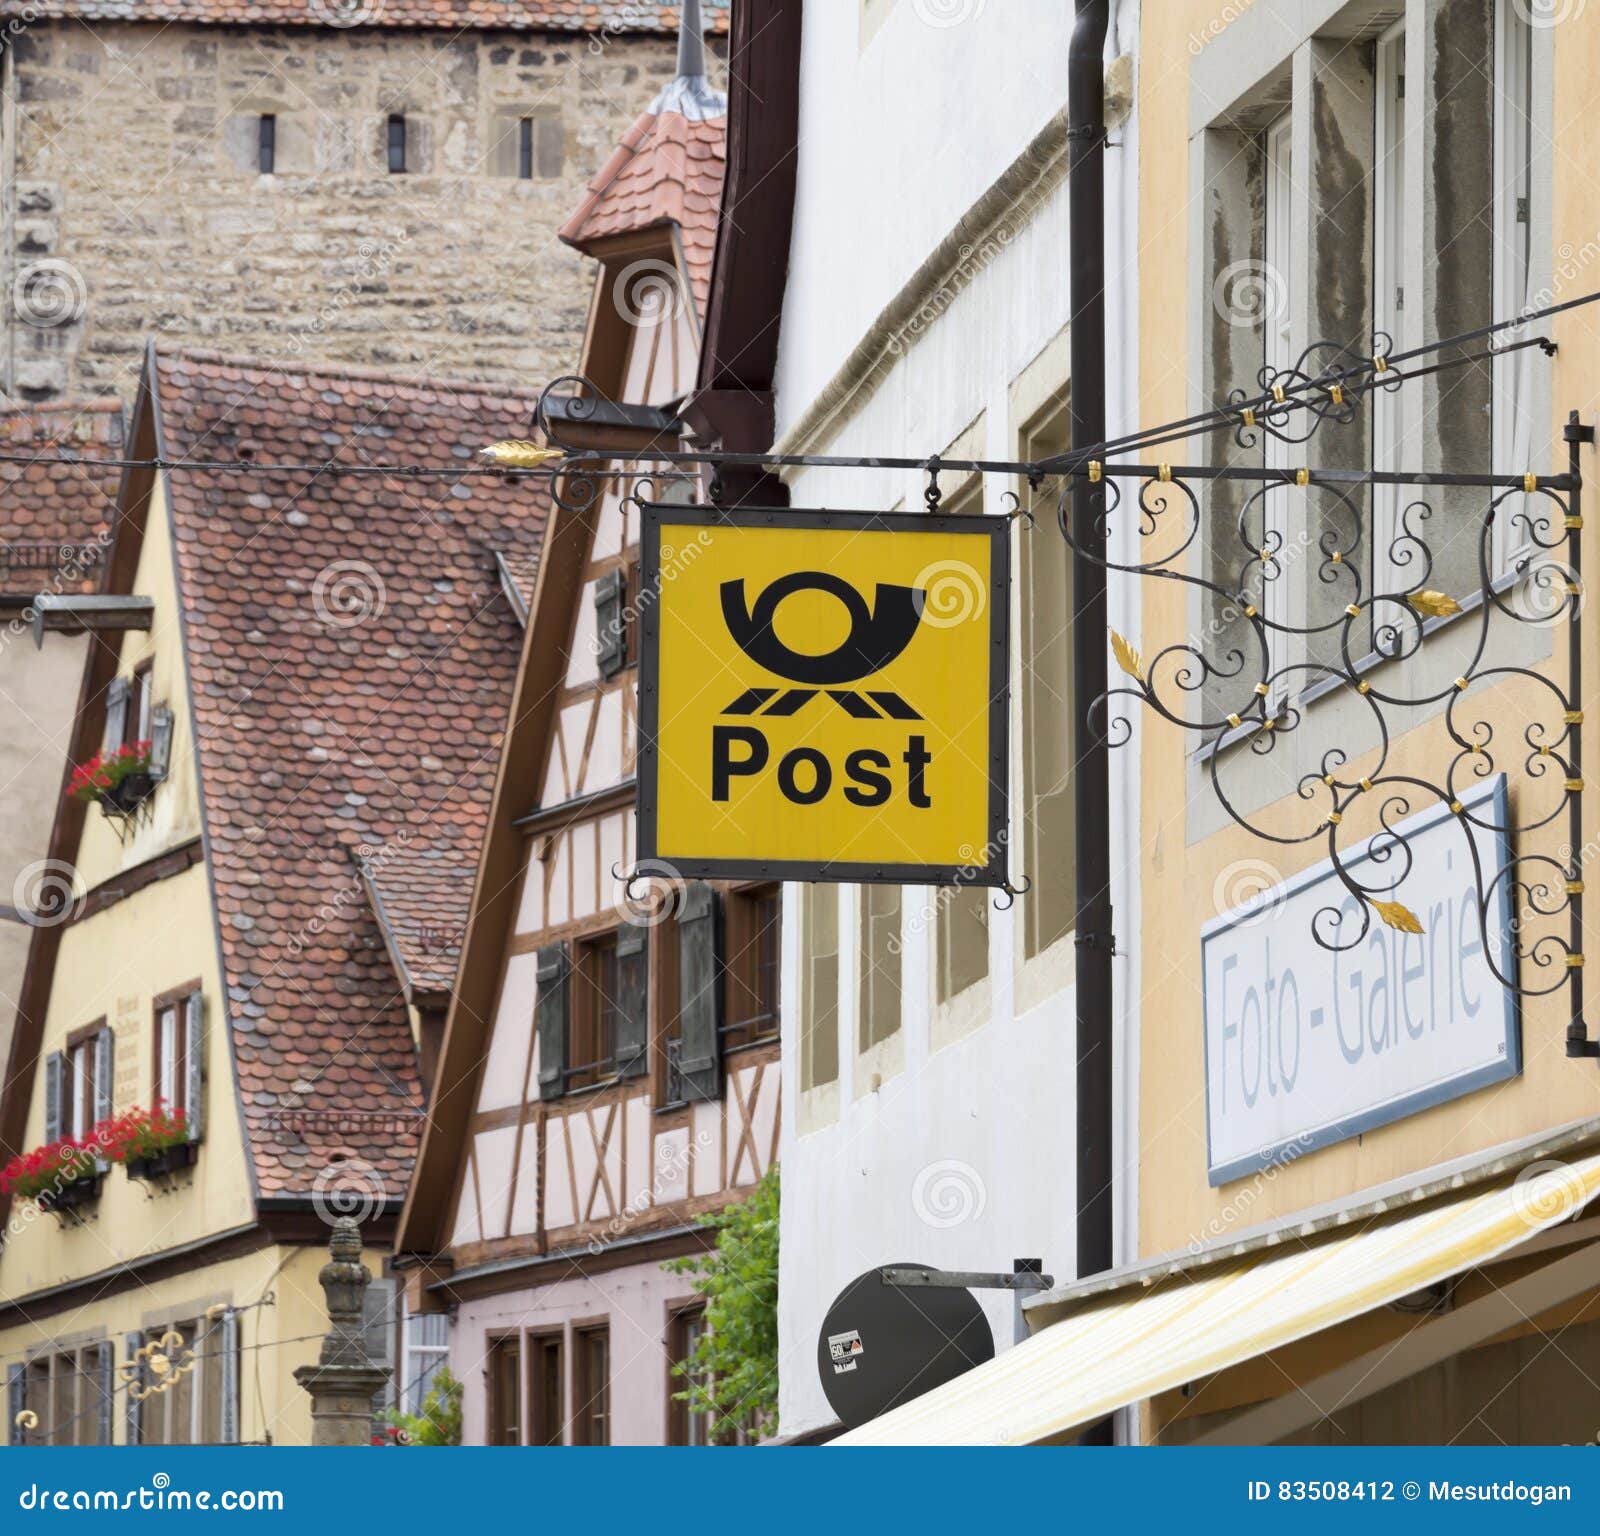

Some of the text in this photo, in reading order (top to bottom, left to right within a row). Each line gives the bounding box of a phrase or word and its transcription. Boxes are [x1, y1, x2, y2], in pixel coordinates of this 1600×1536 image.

[712, 725, 932, 808] Post
[1221, 936, 1300, 1115] Foto
[1333, 849, 1483, 1064] Galerie
